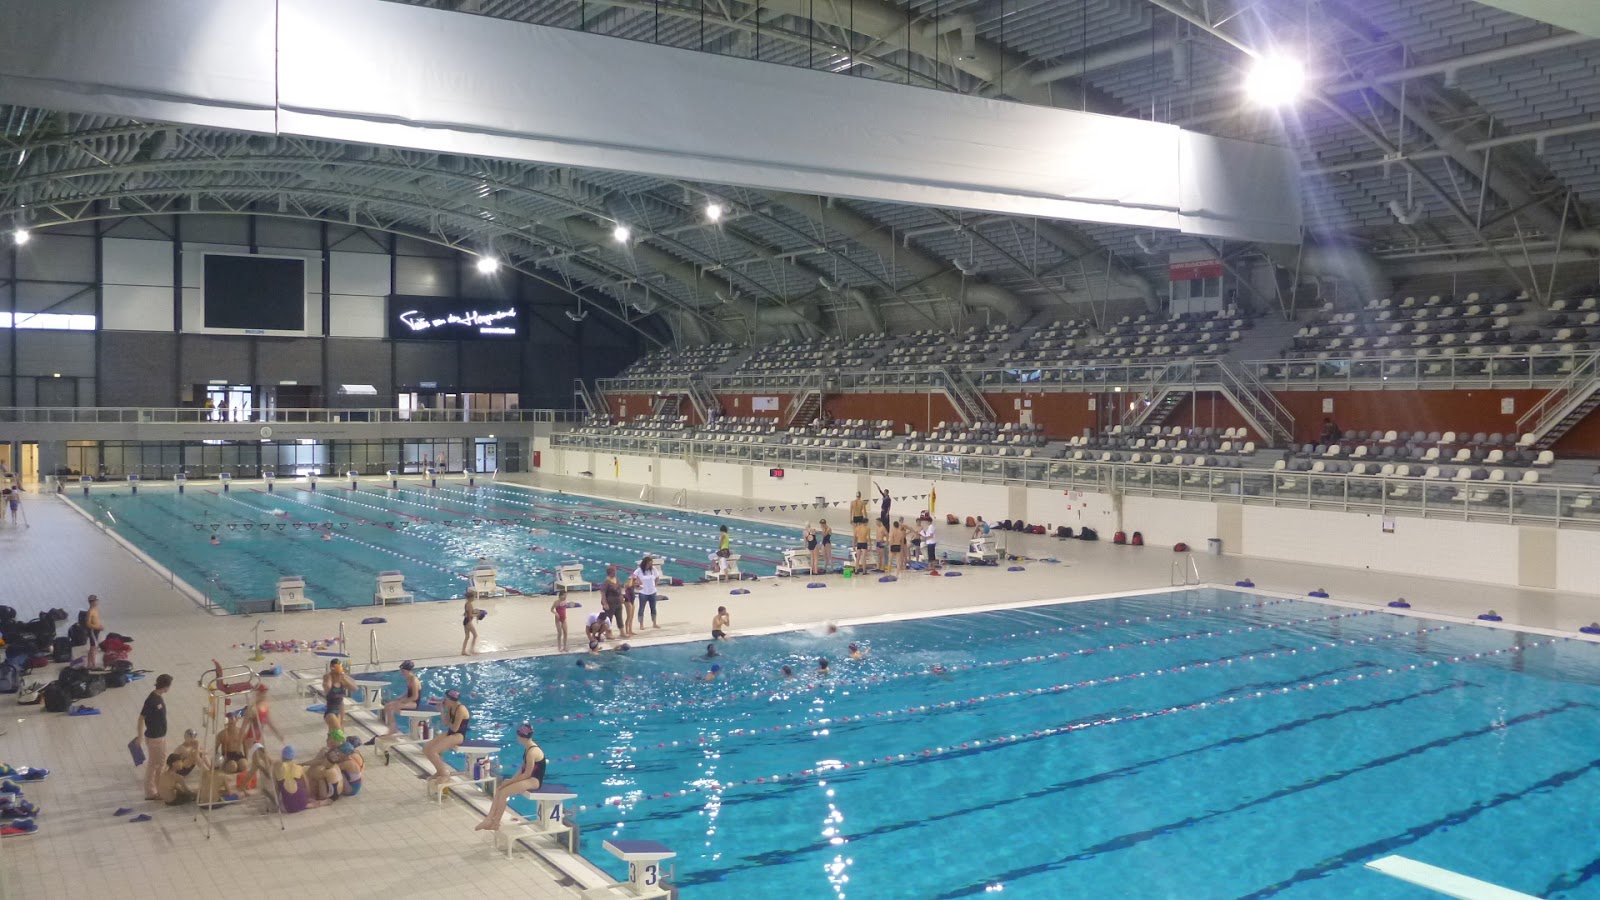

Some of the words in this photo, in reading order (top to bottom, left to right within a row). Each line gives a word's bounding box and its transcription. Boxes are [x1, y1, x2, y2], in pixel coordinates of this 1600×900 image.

[371, 689, 379, 703] 7
[550, 804, 561, 822] 4
[630, 862, 636, 883] 3
[645, 864, 657, 886] 3
